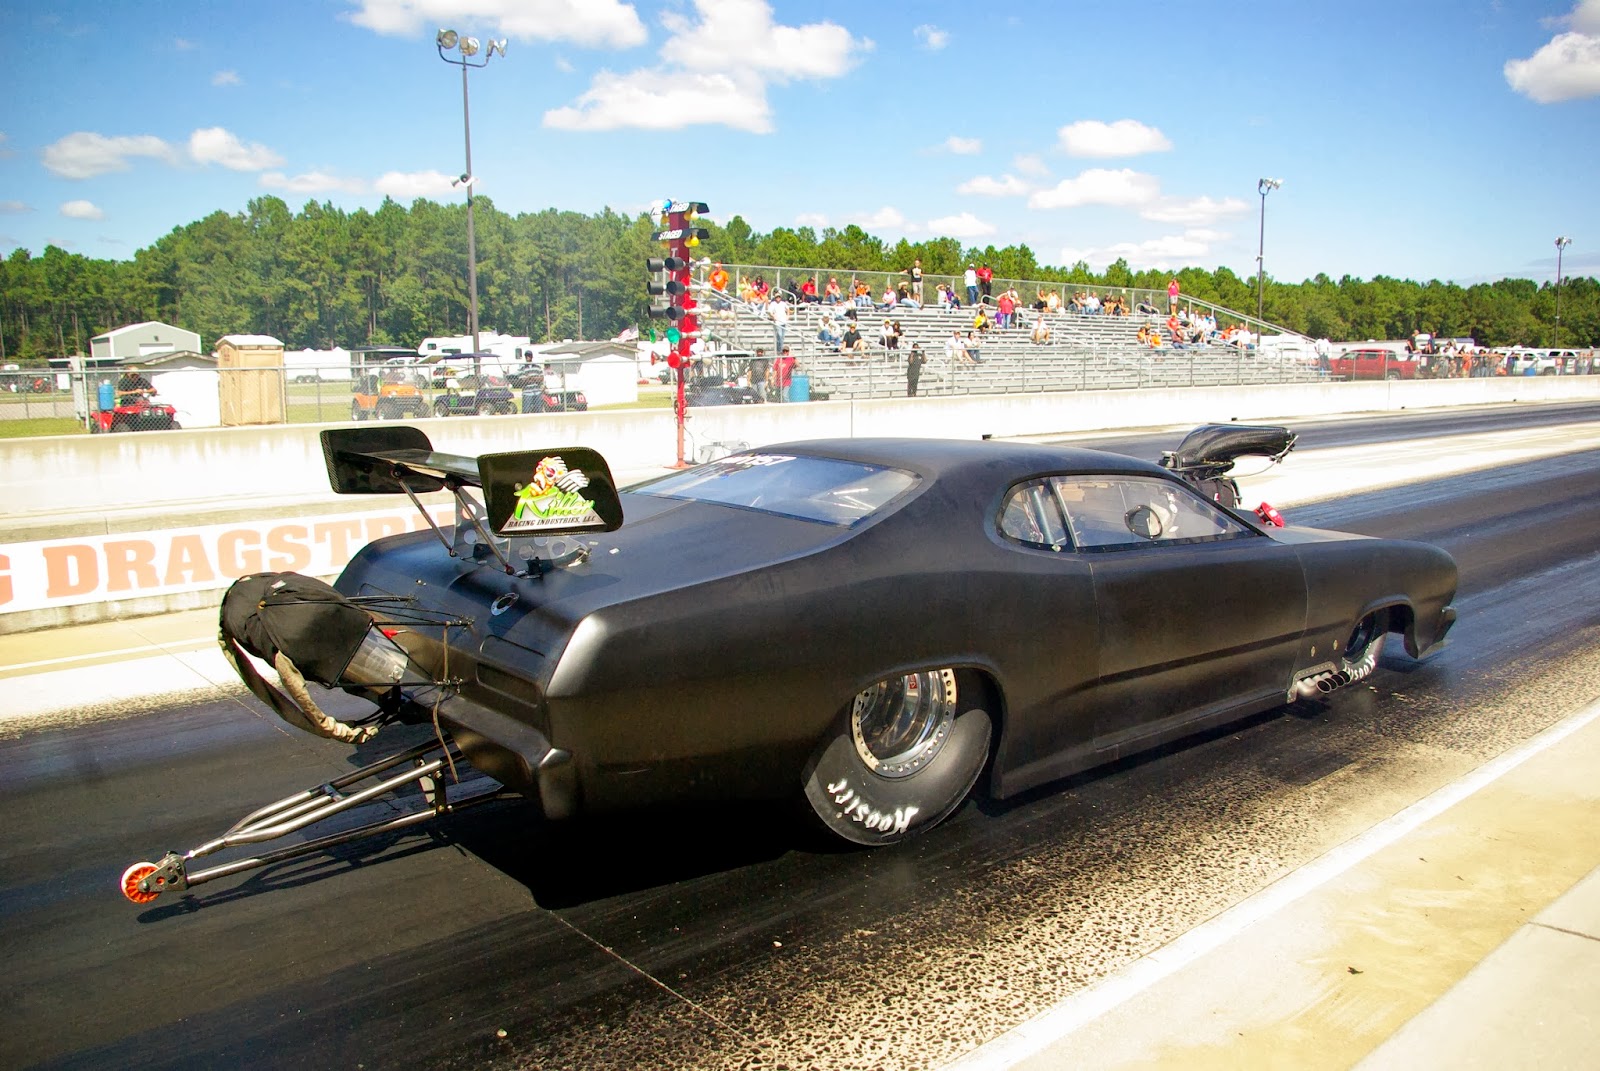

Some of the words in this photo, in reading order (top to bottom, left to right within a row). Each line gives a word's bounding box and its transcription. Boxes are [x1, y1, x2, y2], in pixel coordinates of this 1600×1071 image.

[659, 229, 682, 240] STAGED
[513, 484, 596, 520] Killer
[508, 519, 535, 528] RACING
[537, 516, 580, 526] INDUSTRIES,
[582, 515, 596, 523] LLC
[42, 510, 472, 598] DRAGST
